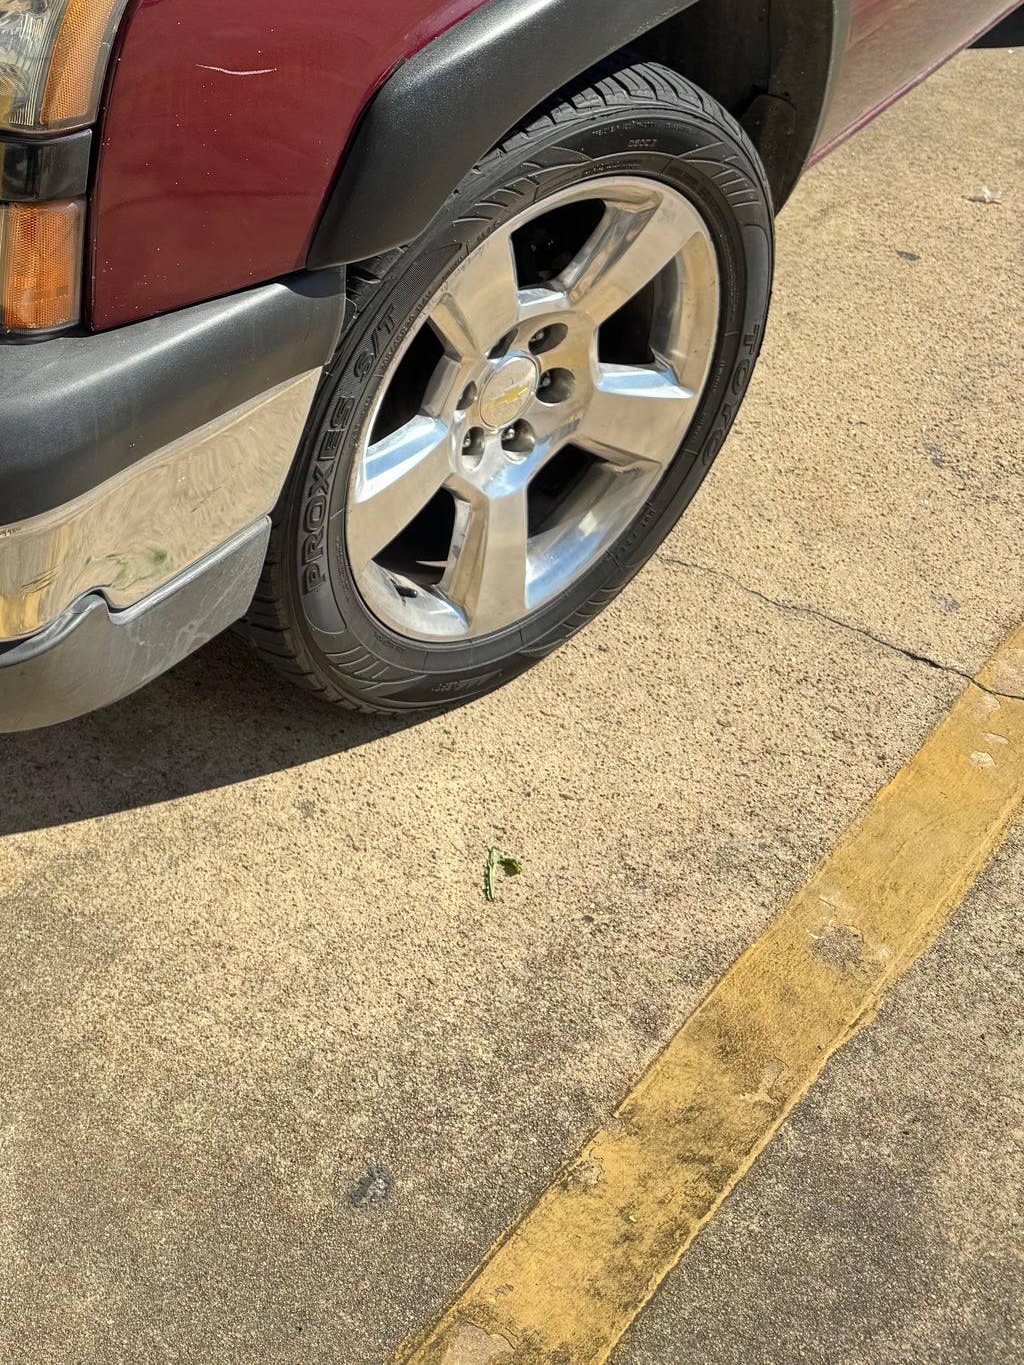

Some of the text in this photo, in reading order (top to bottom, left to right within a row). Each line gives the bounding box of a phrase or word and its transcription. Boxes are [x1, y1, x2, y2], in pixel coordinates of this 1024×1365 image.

[302, 394, 356, 595] PROXES
[353, 303, 395, 383] S/T
[702, 324, 760, 467] TOYO
